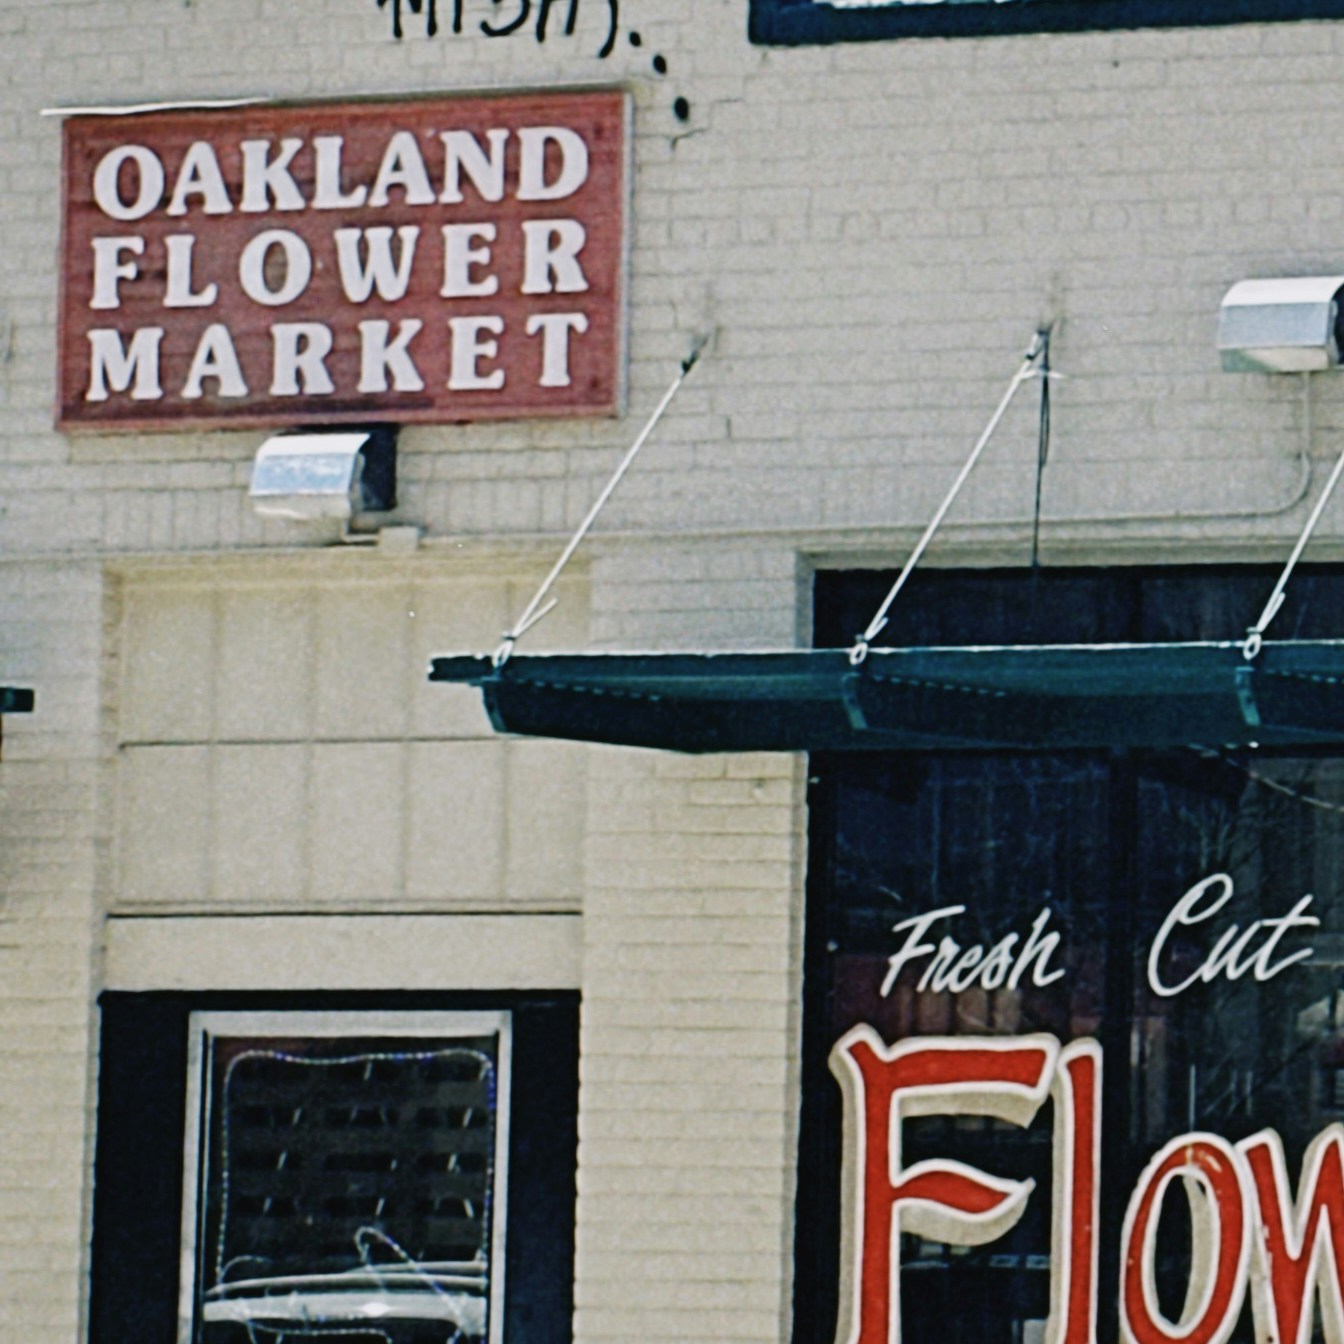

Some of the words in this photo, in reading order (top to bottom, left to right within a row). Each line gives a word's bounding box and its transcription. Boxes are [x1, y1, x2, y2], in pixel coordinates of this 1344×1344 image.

[93, 126, 589, 220] OAKLAND
[89, 219, 589, 309] FLOWER
[86, 312, 589, 401] MARKET
[878, 904, 1066, 997] Fresh
[1146, 872, 1321, 997] Cut
